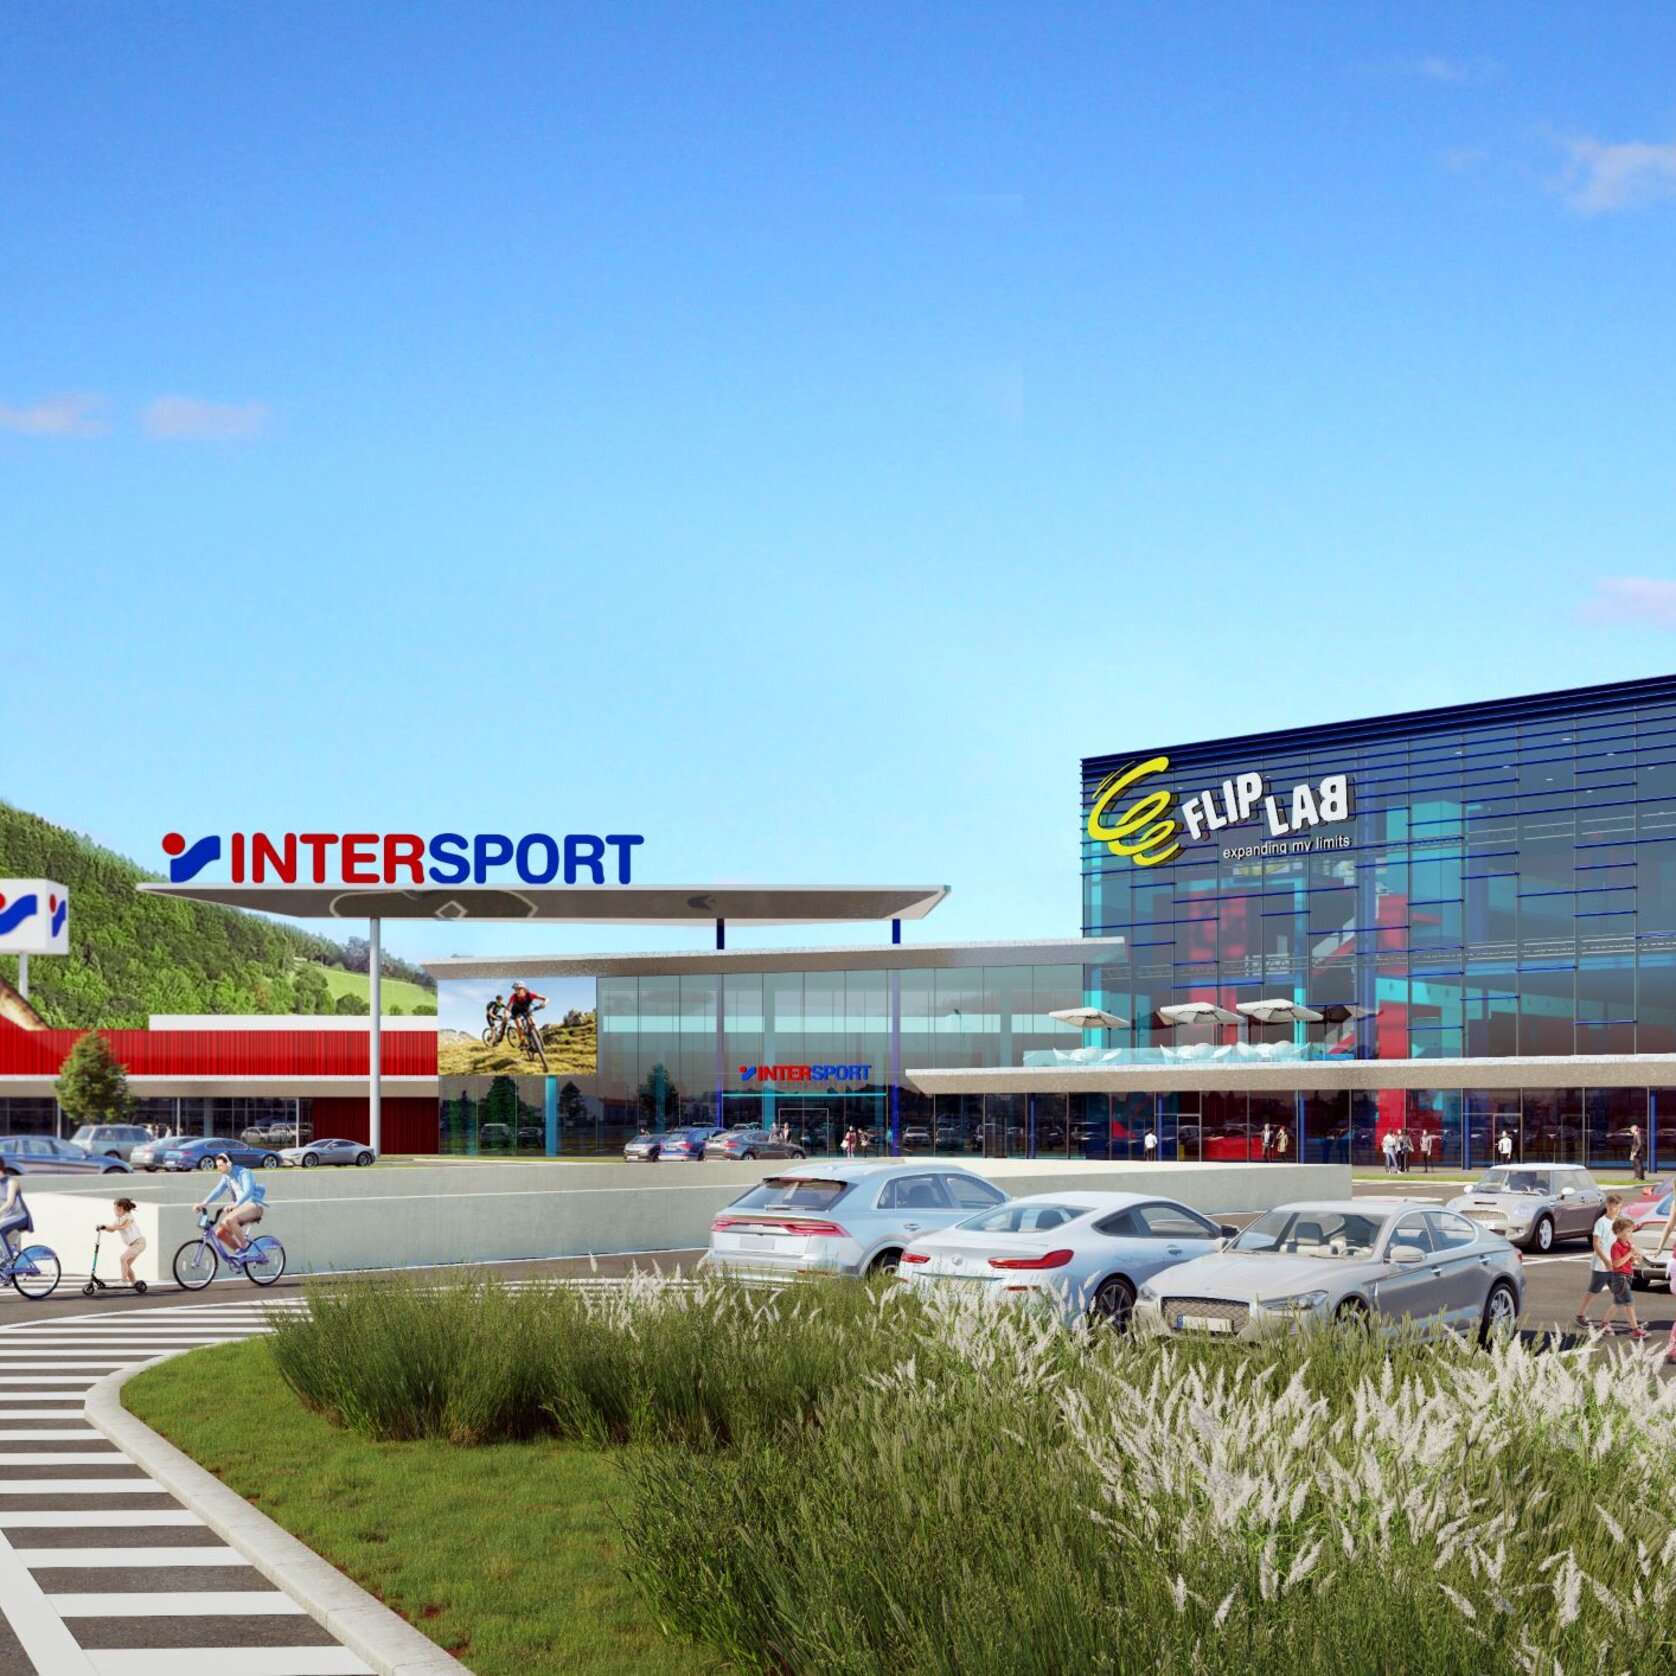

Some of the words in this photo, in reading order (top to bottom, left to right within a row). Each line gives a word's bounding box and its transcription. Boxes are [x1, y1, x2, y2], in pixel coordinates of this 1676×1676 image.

[1181, 772, 1264, 841] FLIP
[1264, 774, 1349, 837] LAB
[231, 832, 645, 885] INTERSPORT
[1222, 842, 1288, 860] expanding
[1292, 839, 1313, 853] my
[1315, 834, 1351, 849] limits
[756, 1064, 871, 1082] INTERSPORT
